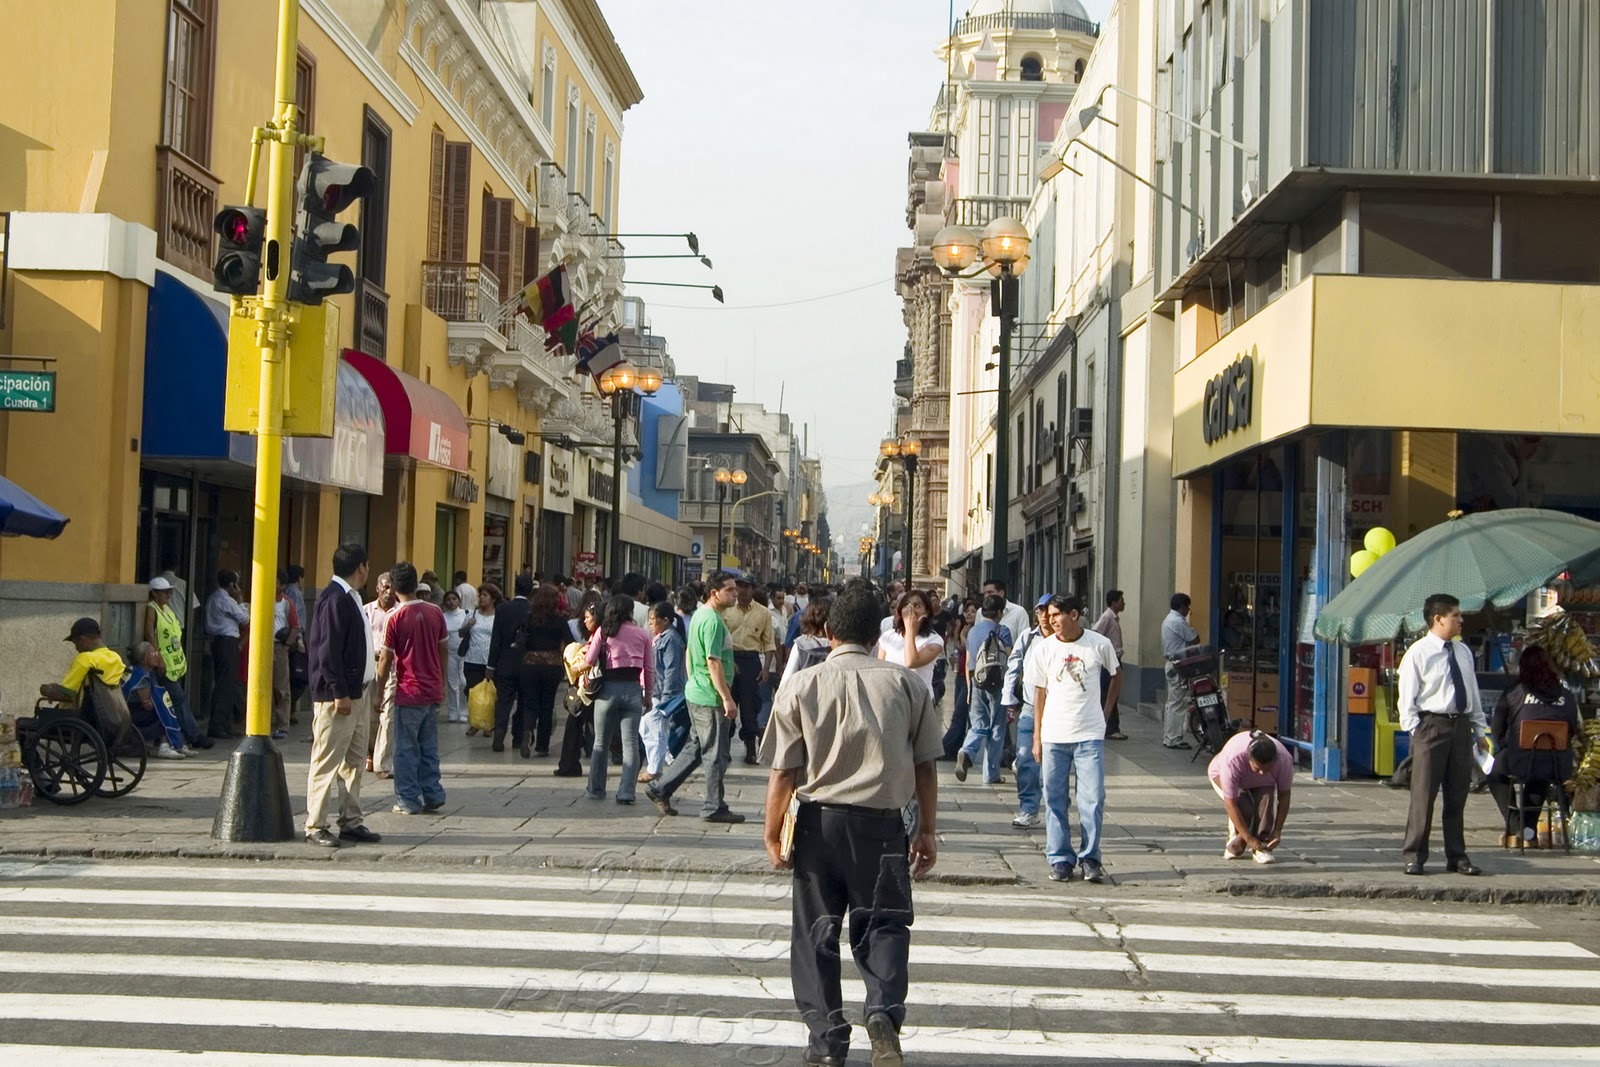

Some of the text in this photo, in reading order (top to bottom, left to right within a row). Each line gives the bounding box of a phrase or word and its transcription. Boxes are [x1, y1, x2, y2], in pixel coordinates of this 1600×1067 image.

[0, 375, 51, 394] cipación
[4, 396, 47, 409] Cuadra 1
[1203, 355, 1253, 446] carsa
[332, 425, 368, 487] KFC
